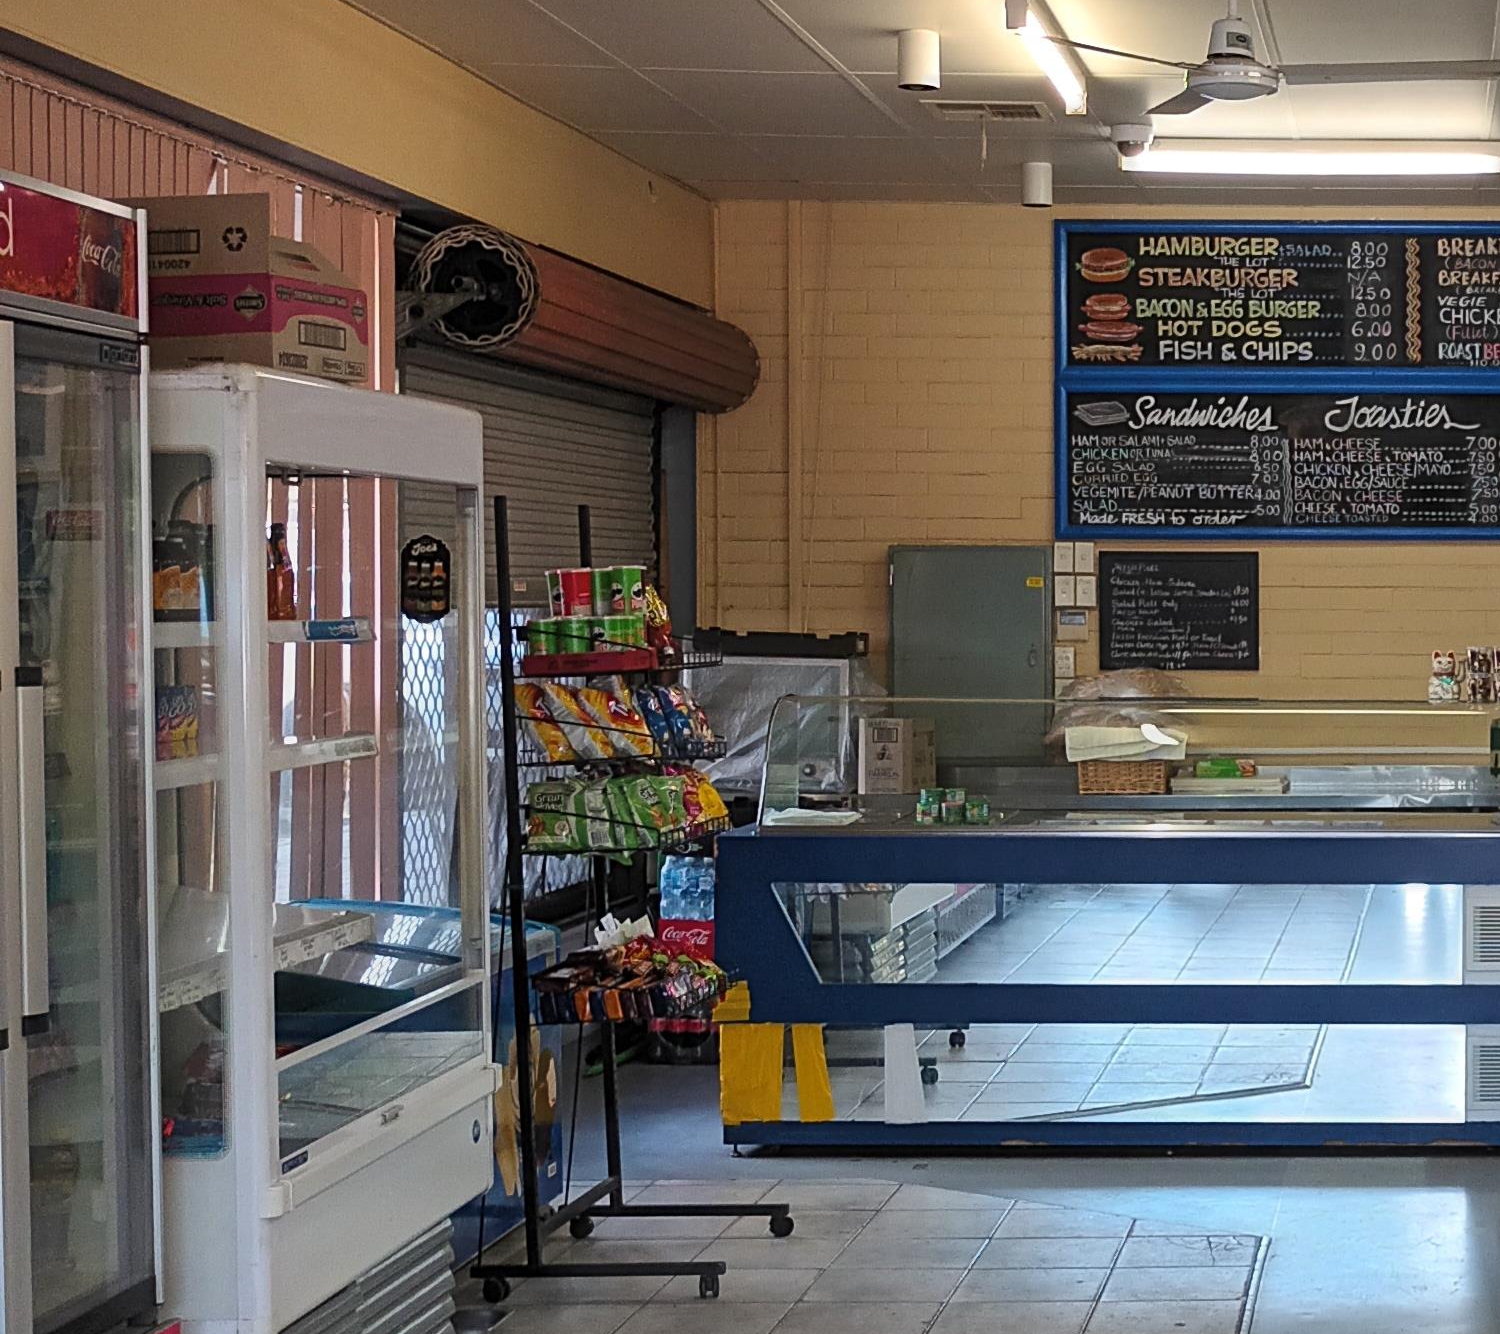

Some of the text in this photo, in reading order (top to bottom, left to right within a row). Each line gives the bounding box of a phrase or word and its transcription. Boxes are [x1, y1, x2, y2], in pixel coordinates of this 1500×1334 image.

[1139, 236, 1280, 256] HAMBURGER
[1350, 241, 1389, 257] 8.00
[1138, 268, 1382, 287] STEAKBURGER N/A
[1136, 298, 1194, 318] BACON
[1196, 301, 1208, 318] &
[1210, 299, 1244, 318] EGG
[1249, 300, 1321, 319] BURGER
[1437, 296, 1487, 307] VEGIE
[1158, 320, 1392, 338] HOT DOGS 6.00
[1159, 340, 1213, 361] FISH
[1221, 343, 1238, 361] &
[1242, 341, 1314, 361] CHIPS
[1438, 342, 1482, 360] ROAST
[1128, 396, 1279, 431] Sandwiches
[1324, 395, 1481, 432] Toasties
[1072, 435, 1099, 447] HAM
[1250, 435, 1279, 449] 8.00
[1294, 438, 1324, 450] HAM
[1332, 438, 1382, 450] CHEESE
[1072, 448, 1129, 460] CHICKEN
[1294, 451, 1324, 463] HAM
[1332, 451, 1382, 463] CHEESE
[1394, 451, 1444, 463] TOMATO
[1073, 462, 1105, 473] EGG
[1112, 462, 1155, 473] SALAD
[1294, 463, 1352, 476] CHICKEN
[1072, 474, 1129, 485] CURRIED
[1134, 473, 1158, 484] EGG
[1294, 477, 1337, 490] BACON
[1344, 476, 1410, 491] EGG/SAUCE
[1072, 486, 1281, 505] VEGEMITE/PEANUT BUTTER 4.00
[1294, 490, 1342, 502] BACON
[1354, 490, 1403, 503] CHEESE
[1073, 499, 1118, 513] SALAD
[1294, 503, 1335, 515] CHEESE
[1351, 503, 1400, 515] TOMATO
[1080, 511, 1248, 525] Made FRESH to order
[1296, 514, 1342, 524] CHEESE
[662, 926, 711, 945] Coca-Cola
